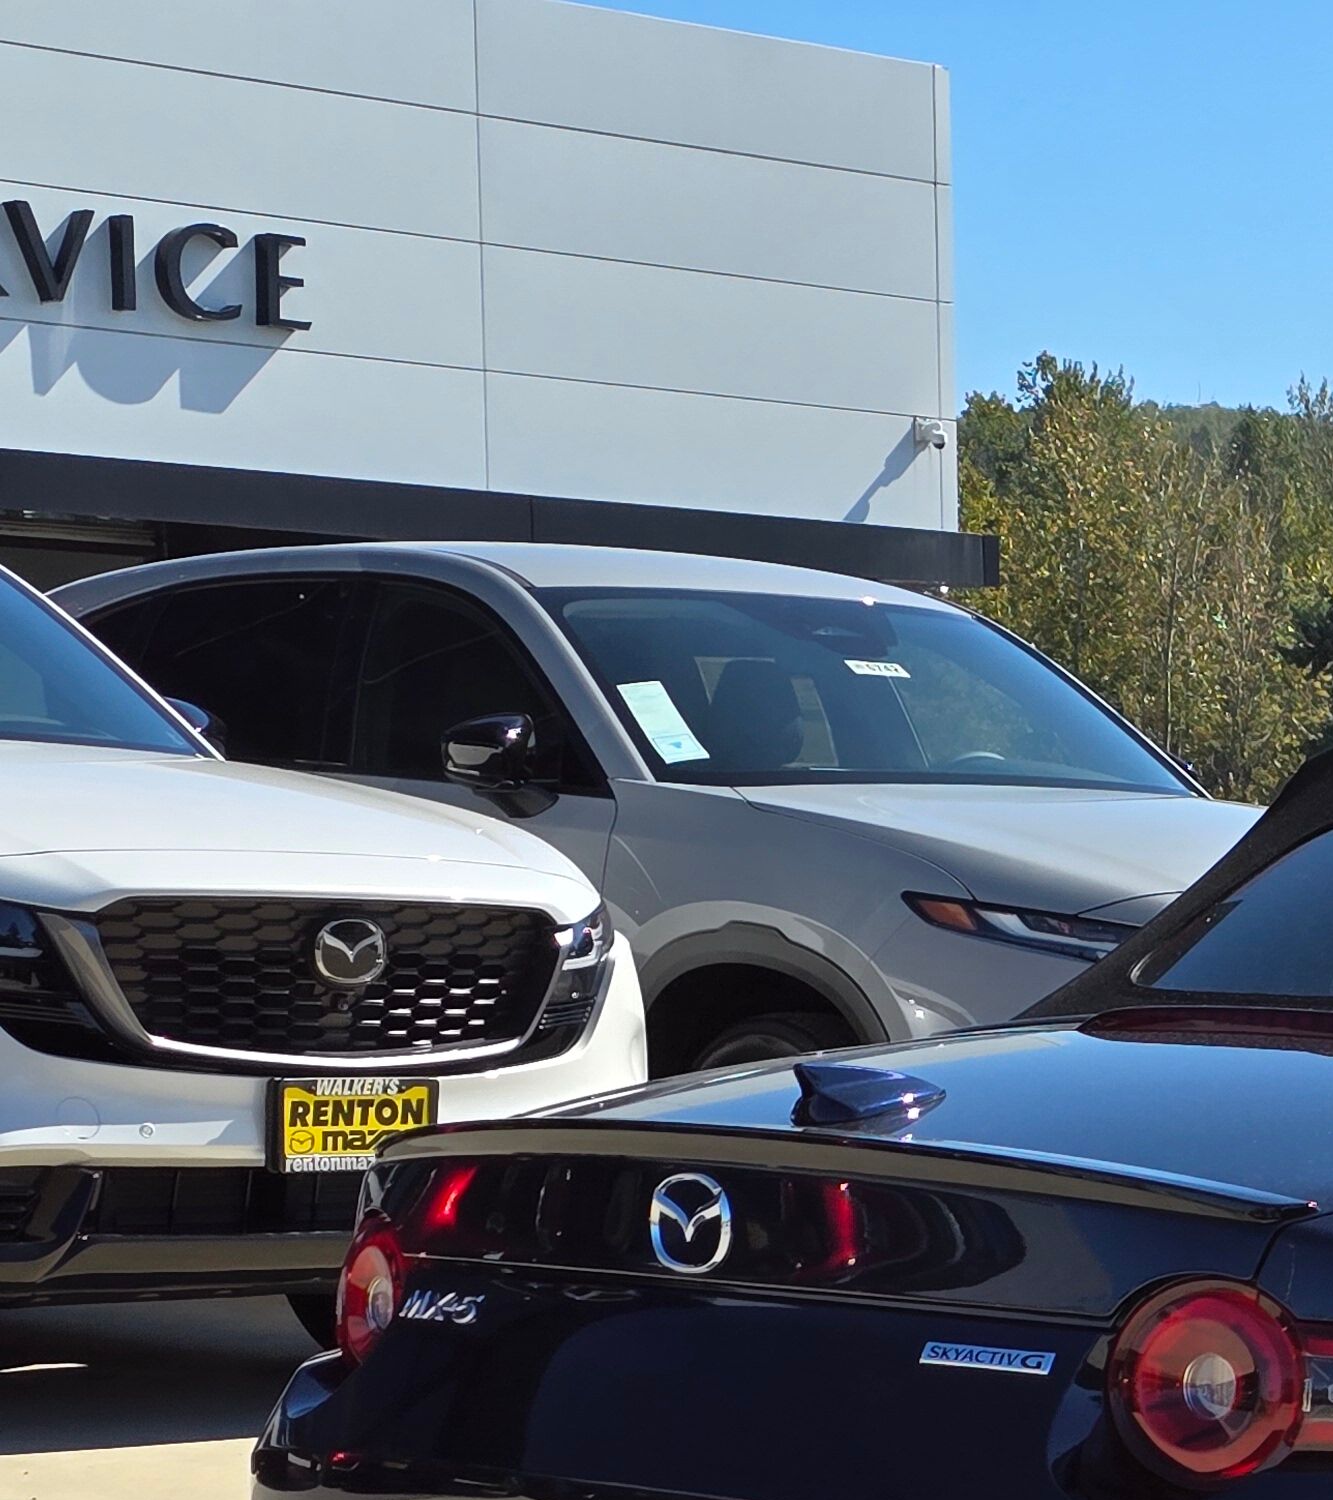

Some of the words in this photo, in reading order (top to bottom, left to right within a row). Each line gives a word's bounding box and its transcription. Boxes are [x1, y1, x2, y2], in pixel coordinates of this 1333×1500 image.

[0, 200, 312, 331] VICE
[315, 1078, 401, 1096] WALKER'S
[288, 1098, 425, 1127] RENTON
[321, 1129, 398, 1152] maz
[398, 1290, 486, 1324] MX-5
[927, 1345, 1020, 1366] SKYACTIV
[1020, 1353, 1046, 1370] G
